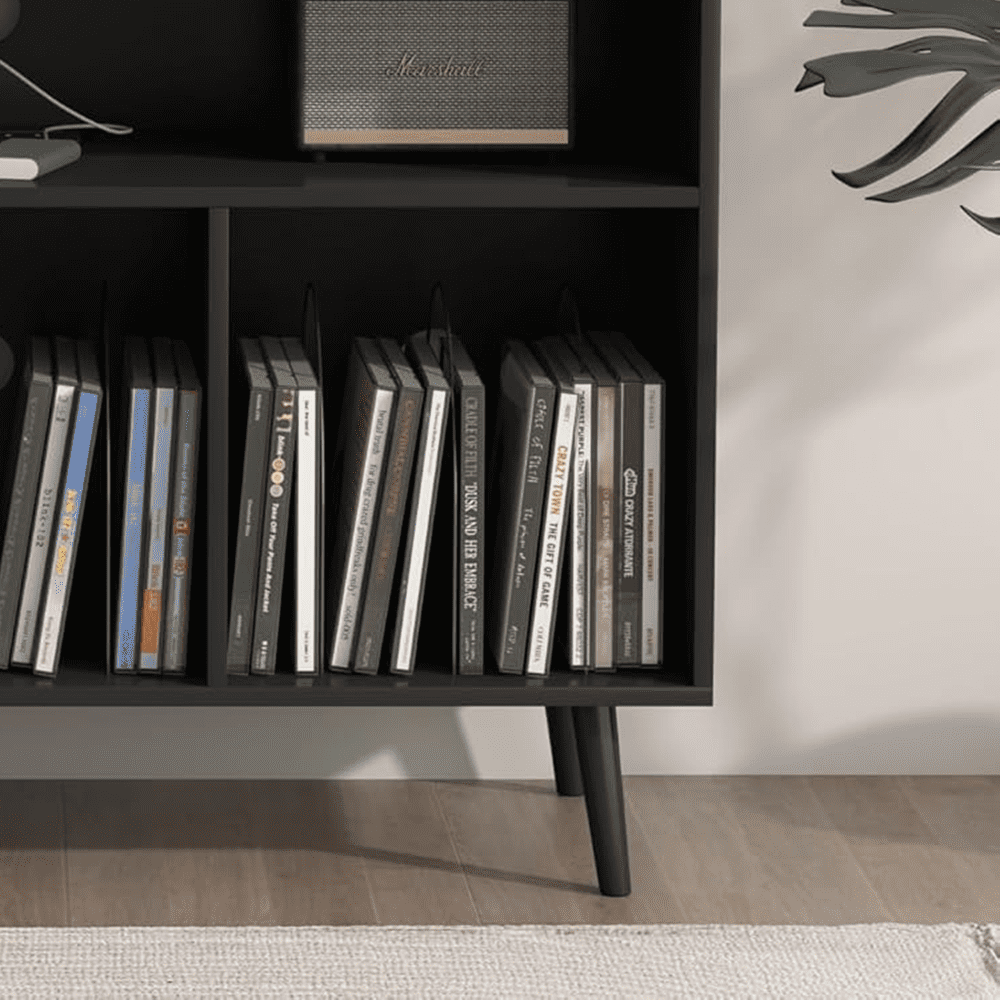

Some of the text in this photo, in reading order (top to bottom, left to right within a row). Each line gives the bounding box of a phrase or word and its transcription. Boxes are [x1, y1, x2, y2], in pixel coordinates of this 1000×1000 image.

[375, 410, 387, 433] brutal
[465, 397, 478, 434] CRADLE
[465, 435, 478, 449] OF
[368, 464, 377, 476] for
[465, 450, 478, 478] FILTH
[554, 445, 568, 480] CRAZY
[363, 478, 376, 497] drug
[550, 483, 563, 515] TOWN
[270, 503, 279, 520] Take
[360, 498, 372, 526] crazed
[625, 499, 634, 526] CRAZY
[465, 514, 478, 536] AND
[548, 522, 558, 540] THE
[268, 534, 277, 549] Your
[464, 539, 478, 559] HER
[266, 551, 275, 572] Pants
[545, 543, 555, 563] GIFT
[624, 527, 634, 578] ATORRANTE
[264, 573, 272, 588] And
[544, 567, 552, 578] OF
[262, 589, 271, 613] Jacket
[539, 581, 550, 608] GAME
